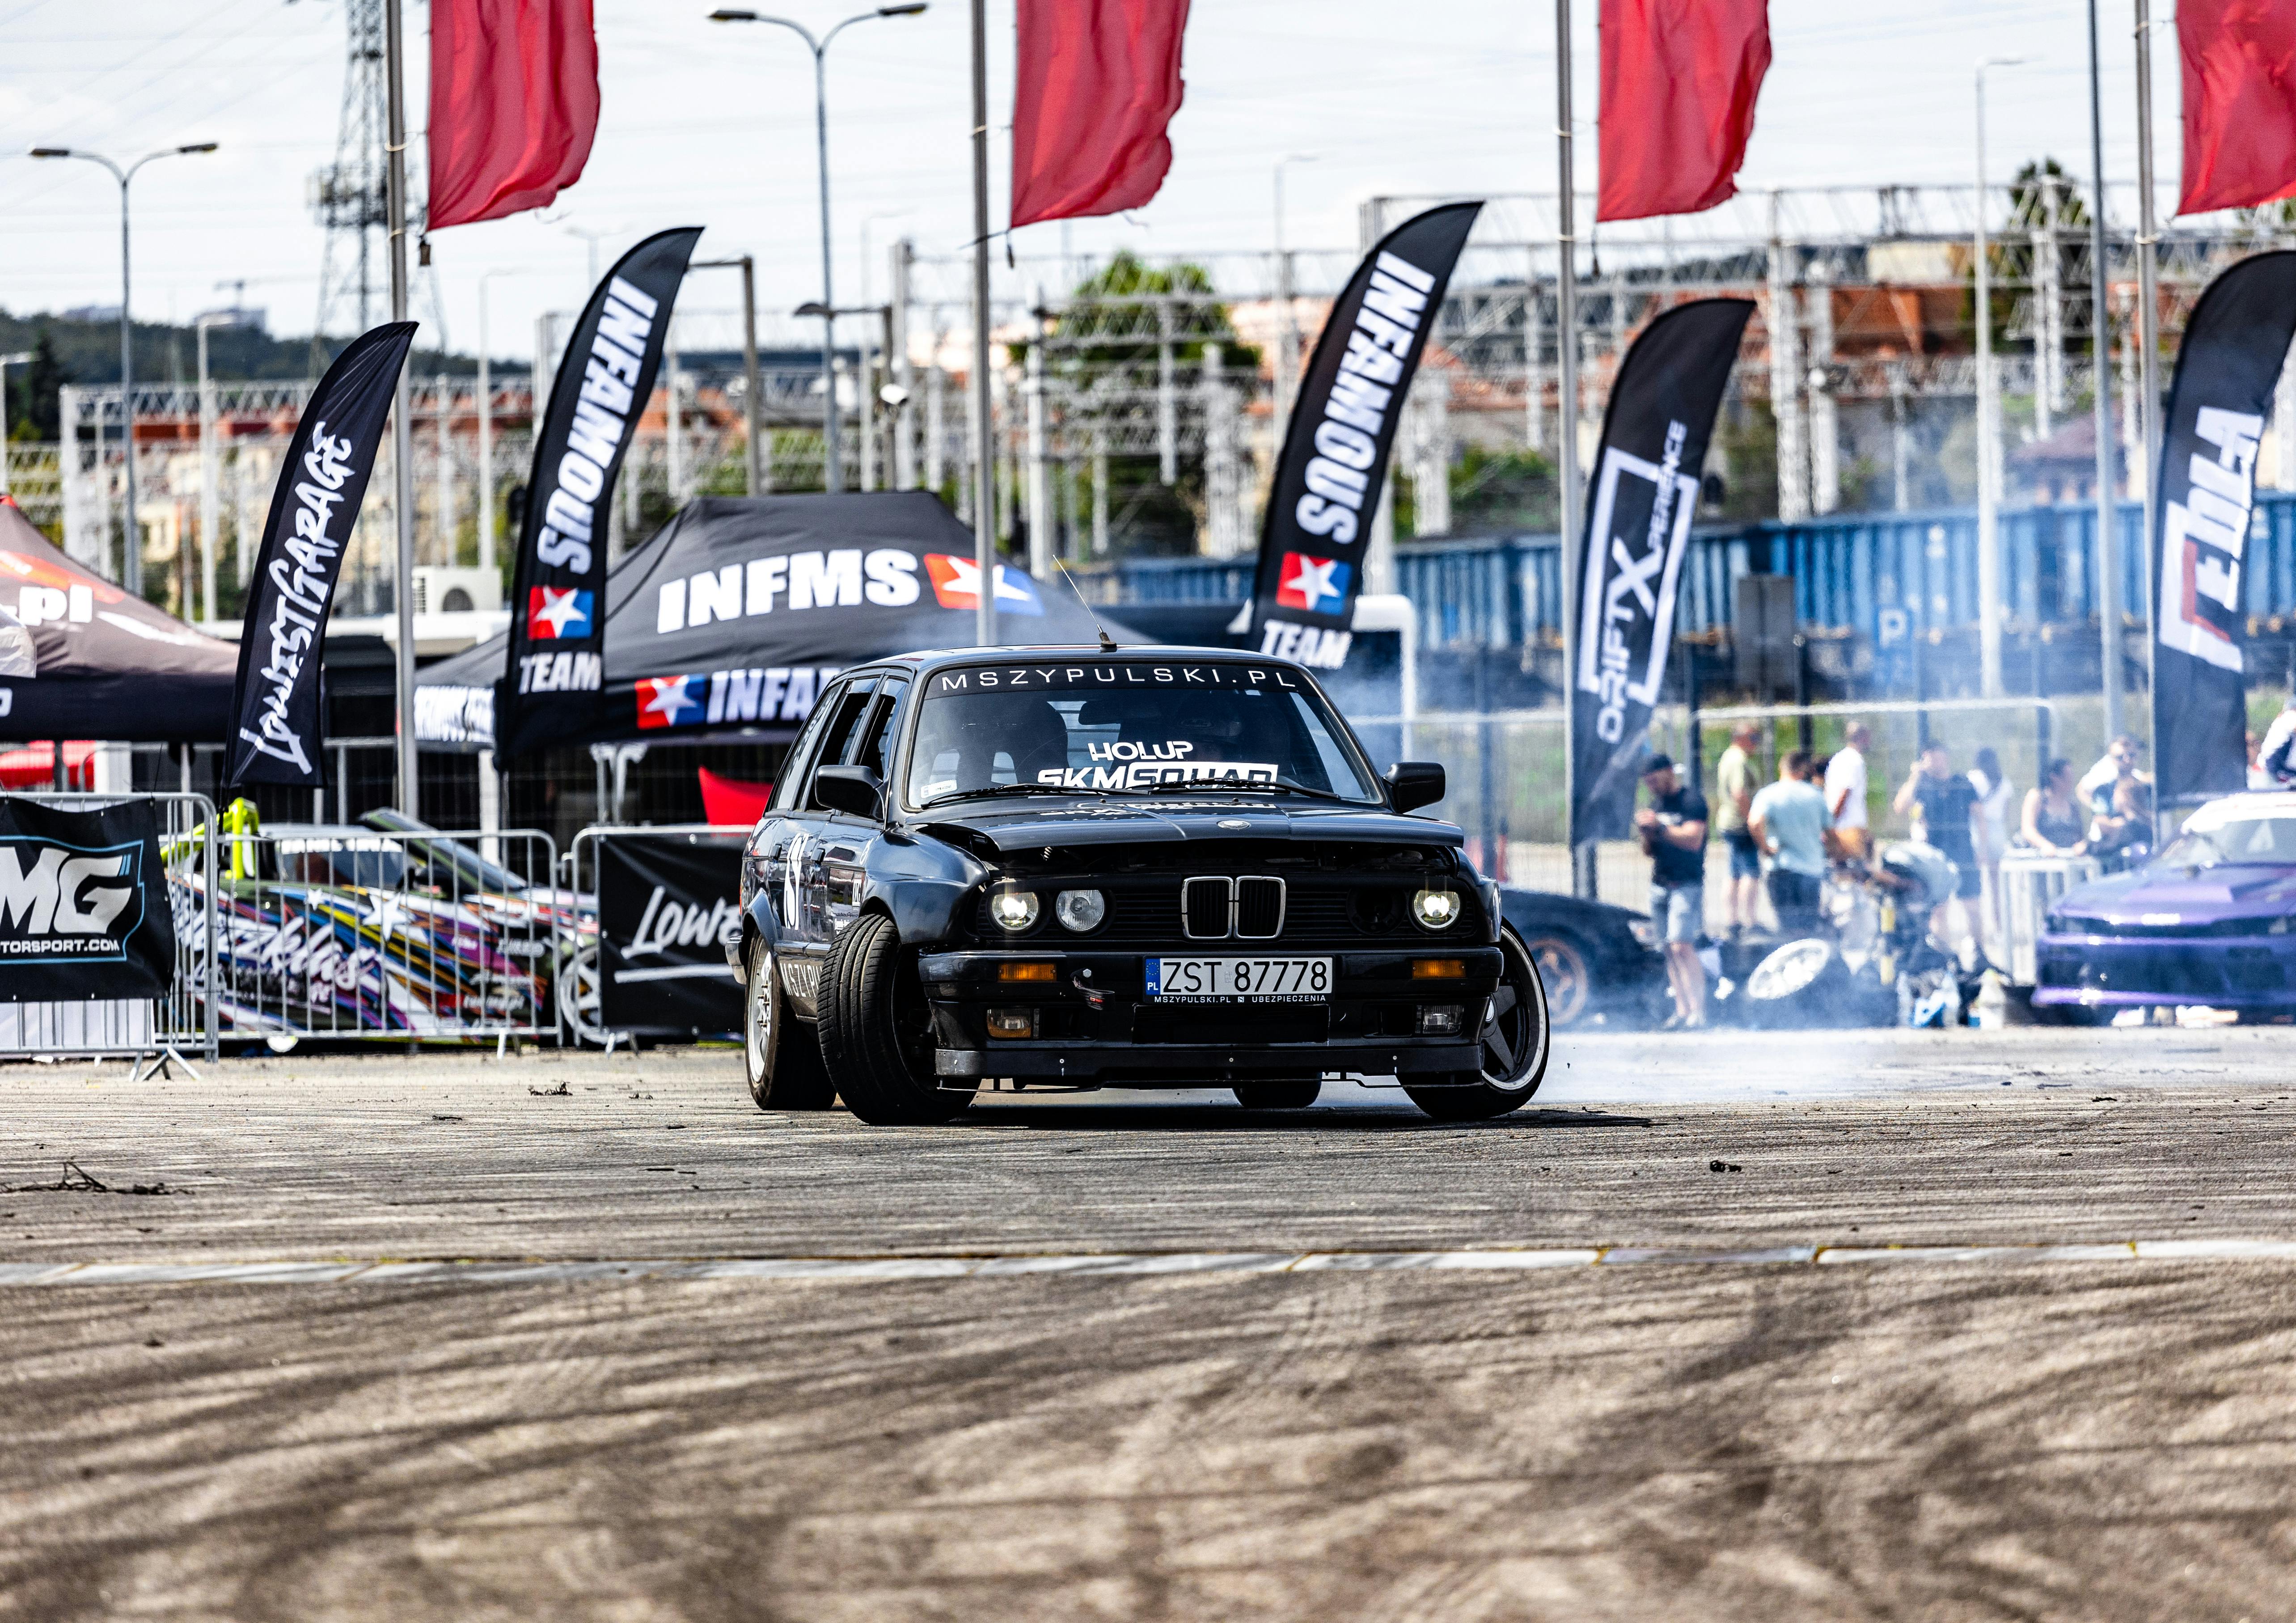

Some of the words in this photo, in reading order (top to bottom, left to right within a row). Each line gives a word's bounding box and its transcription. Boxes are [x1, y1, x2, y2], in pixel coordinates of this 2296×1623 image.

[1295, 250, 1436, 545] INFAMOUS
[537, 275, 659, 575] INFAMOUS
[657, 548, 920, 634] INFMS
[1260, 619, 1353, 670] TEAM
[518, 651, 602, 695] TEAM
[706, 667, 842, 724] INFA
[942, 668, 1295, 691] MSZYPULSKI.PL
[1088, 741, 1193, 761] HOLUP
[1148, 982, 1159, 991] PL
[1163, 961, 1222, 992] ZST
[1234, 960, 1327, 992] 87778
